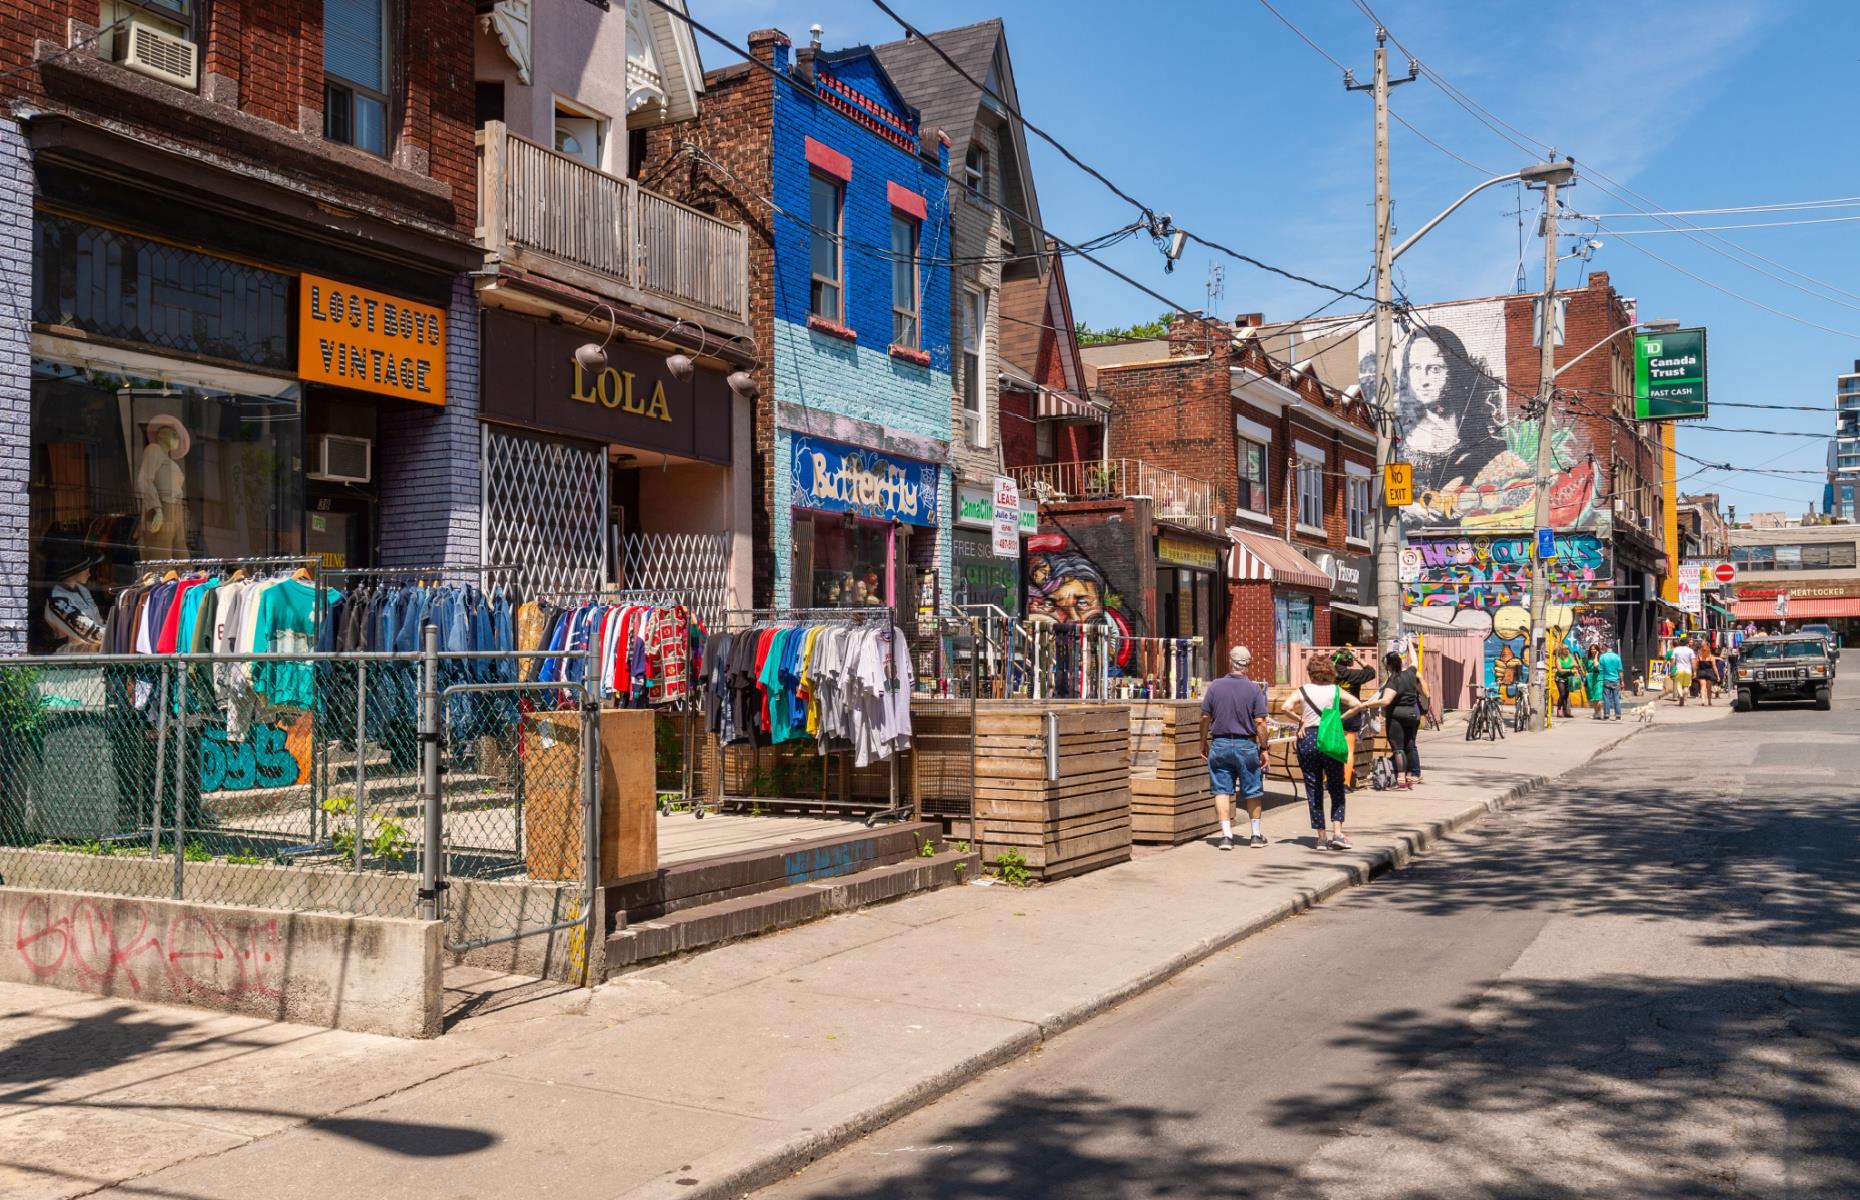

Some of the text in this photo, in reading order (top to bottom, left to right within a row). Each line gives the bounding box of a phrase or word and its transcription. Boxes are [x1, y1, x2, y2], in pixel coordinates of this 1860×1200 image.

[311, 285, 440, 346] LOST BOYS
[1644, 342, 1661, 354] TD
[319, 338, 431, 393] VINTAGE
[1650, 356, 1696, 367] Canada
[1650, 367, 1685, 377] Trust
[571, 358, 672, 422] LOLA
[1650, 388, 1692, 397] FAST CASH
[810, 451, 918, 517] Butterfly
[1391, 471, 1403, 484] NO
[997, 492, 1017, 506] LEASE
[1390, 488, 1406, 500] EXIT
[953, 540, 976, 556] FREE
[1790, 589, 1811, 597] MEAT
[1813, 588, 1844, 596] LOCKER
